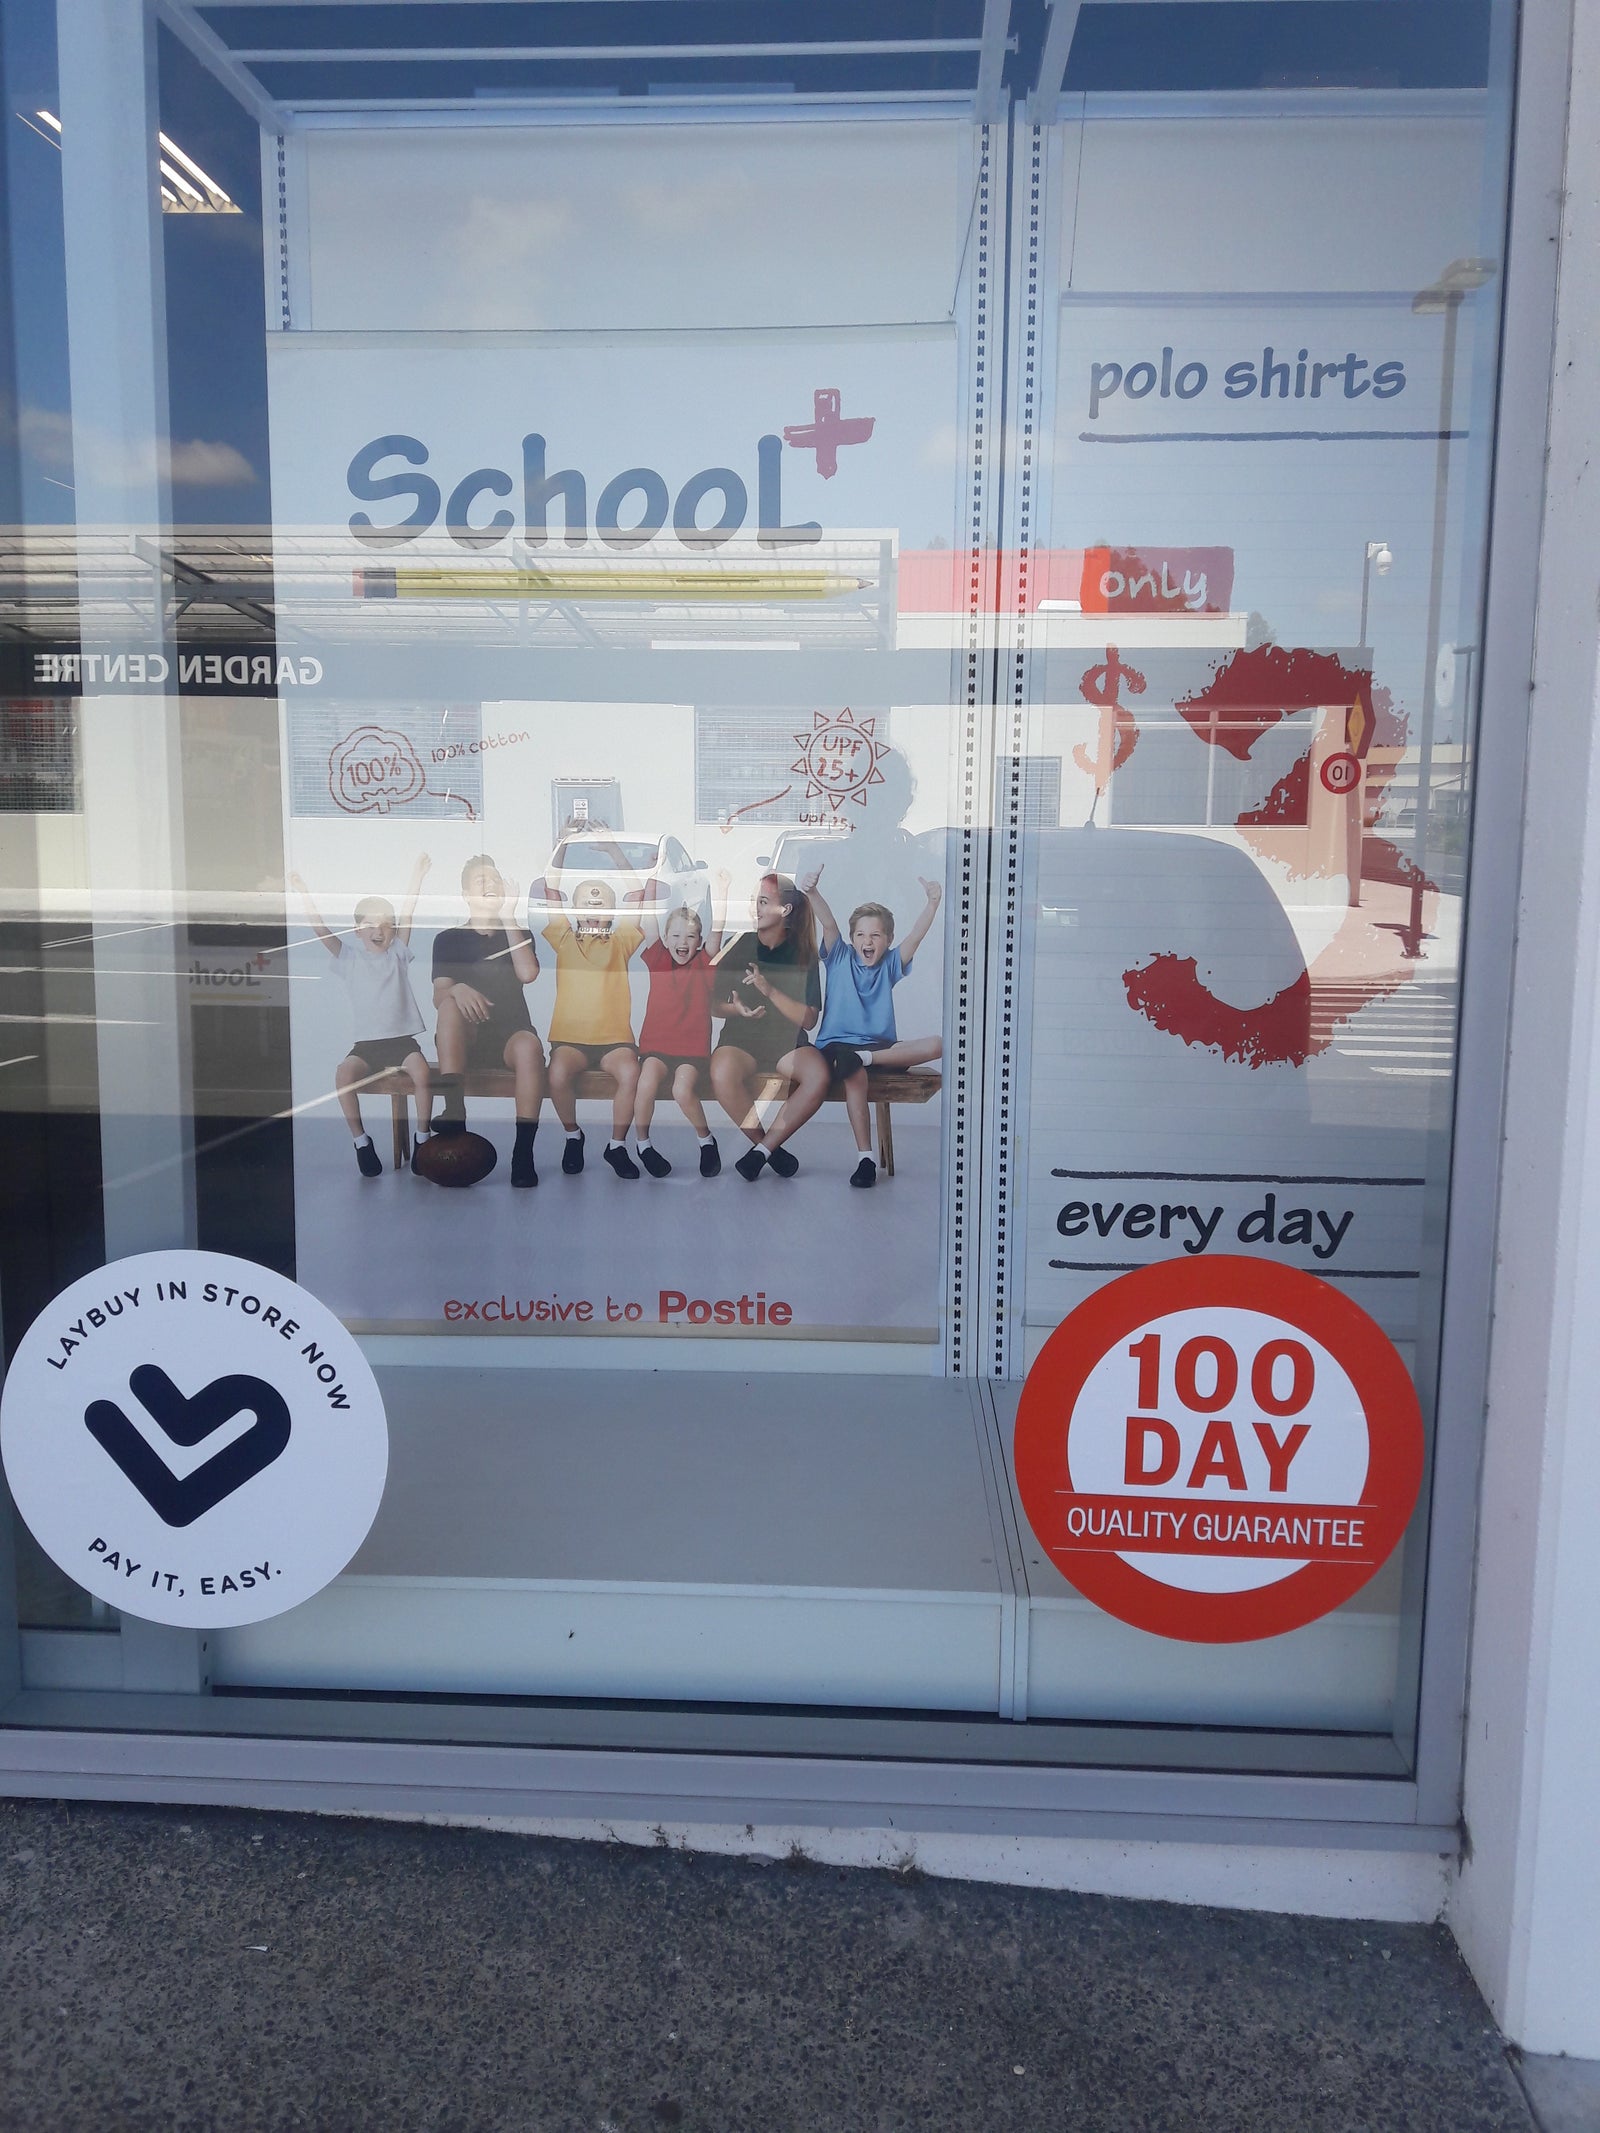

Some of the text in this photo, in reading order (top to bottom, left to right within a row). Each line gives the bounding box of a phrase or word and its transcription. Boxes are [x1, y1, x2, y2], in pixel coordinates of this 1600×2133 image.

[1088, 347, 1407, 419] polo shirts
[1099, 561, 1208, 609] only
[347, 751, 402, 787] 100%
[431, 730, 530, 763] 100% cotton
[817, 757, 859, 782] 25+
[823, 735, 863, 756] UPF
[1056, 1193, 1354, 1259] every day
[443, 1290, 793, 1326] exclusive to Postie
[47, 1280, 351, 1410] LAYBUY IN STORE NOW
[1128, 1333, 1315, 1417] 100
[1123, 1416, 1312, 1493] DAY
[1066, 1507, 1364, 1547] QUALITY GUARANTEE
[88, 1537, 282, 1597] PAY IT, EASY.
